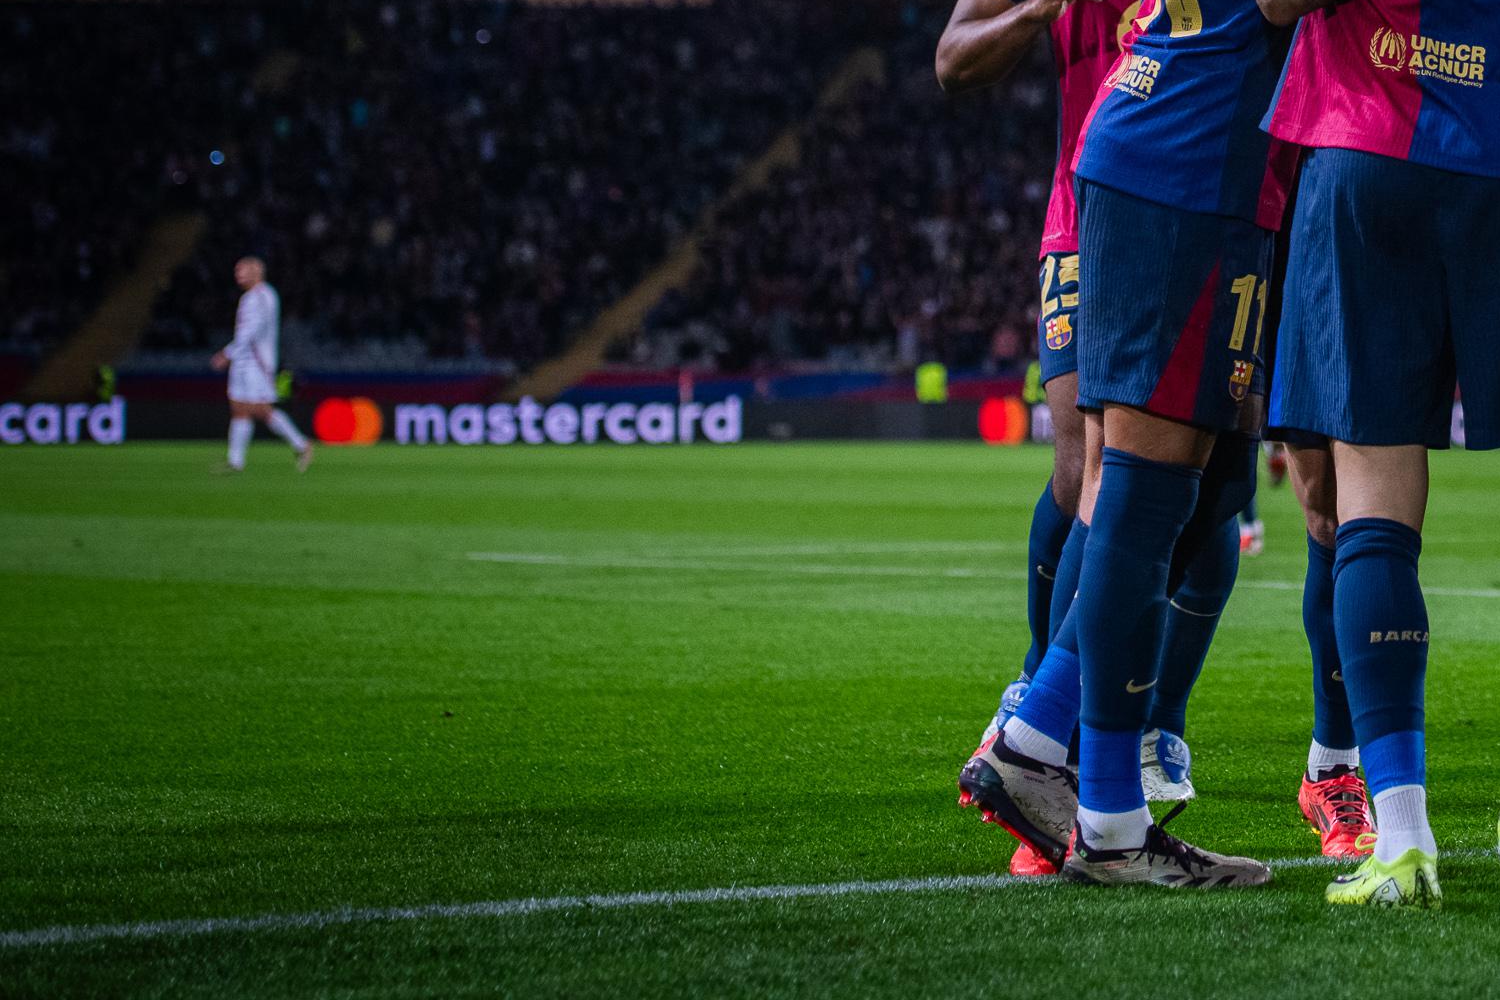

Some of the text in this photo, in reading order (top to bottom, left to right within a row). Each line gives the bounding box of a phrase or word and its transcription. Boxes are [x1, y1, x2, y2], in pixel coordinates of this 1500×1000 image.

[1411, 34, 1486, 63] UNHCR
[1408, 51, 1484, 80] ACNUR
[1421, 69, 1431, 77] UN
[1458, 79, 1483, 88] Agency
[1228, 274, 1268, 355] 11
[394, 395, 743, 445] mastercard
